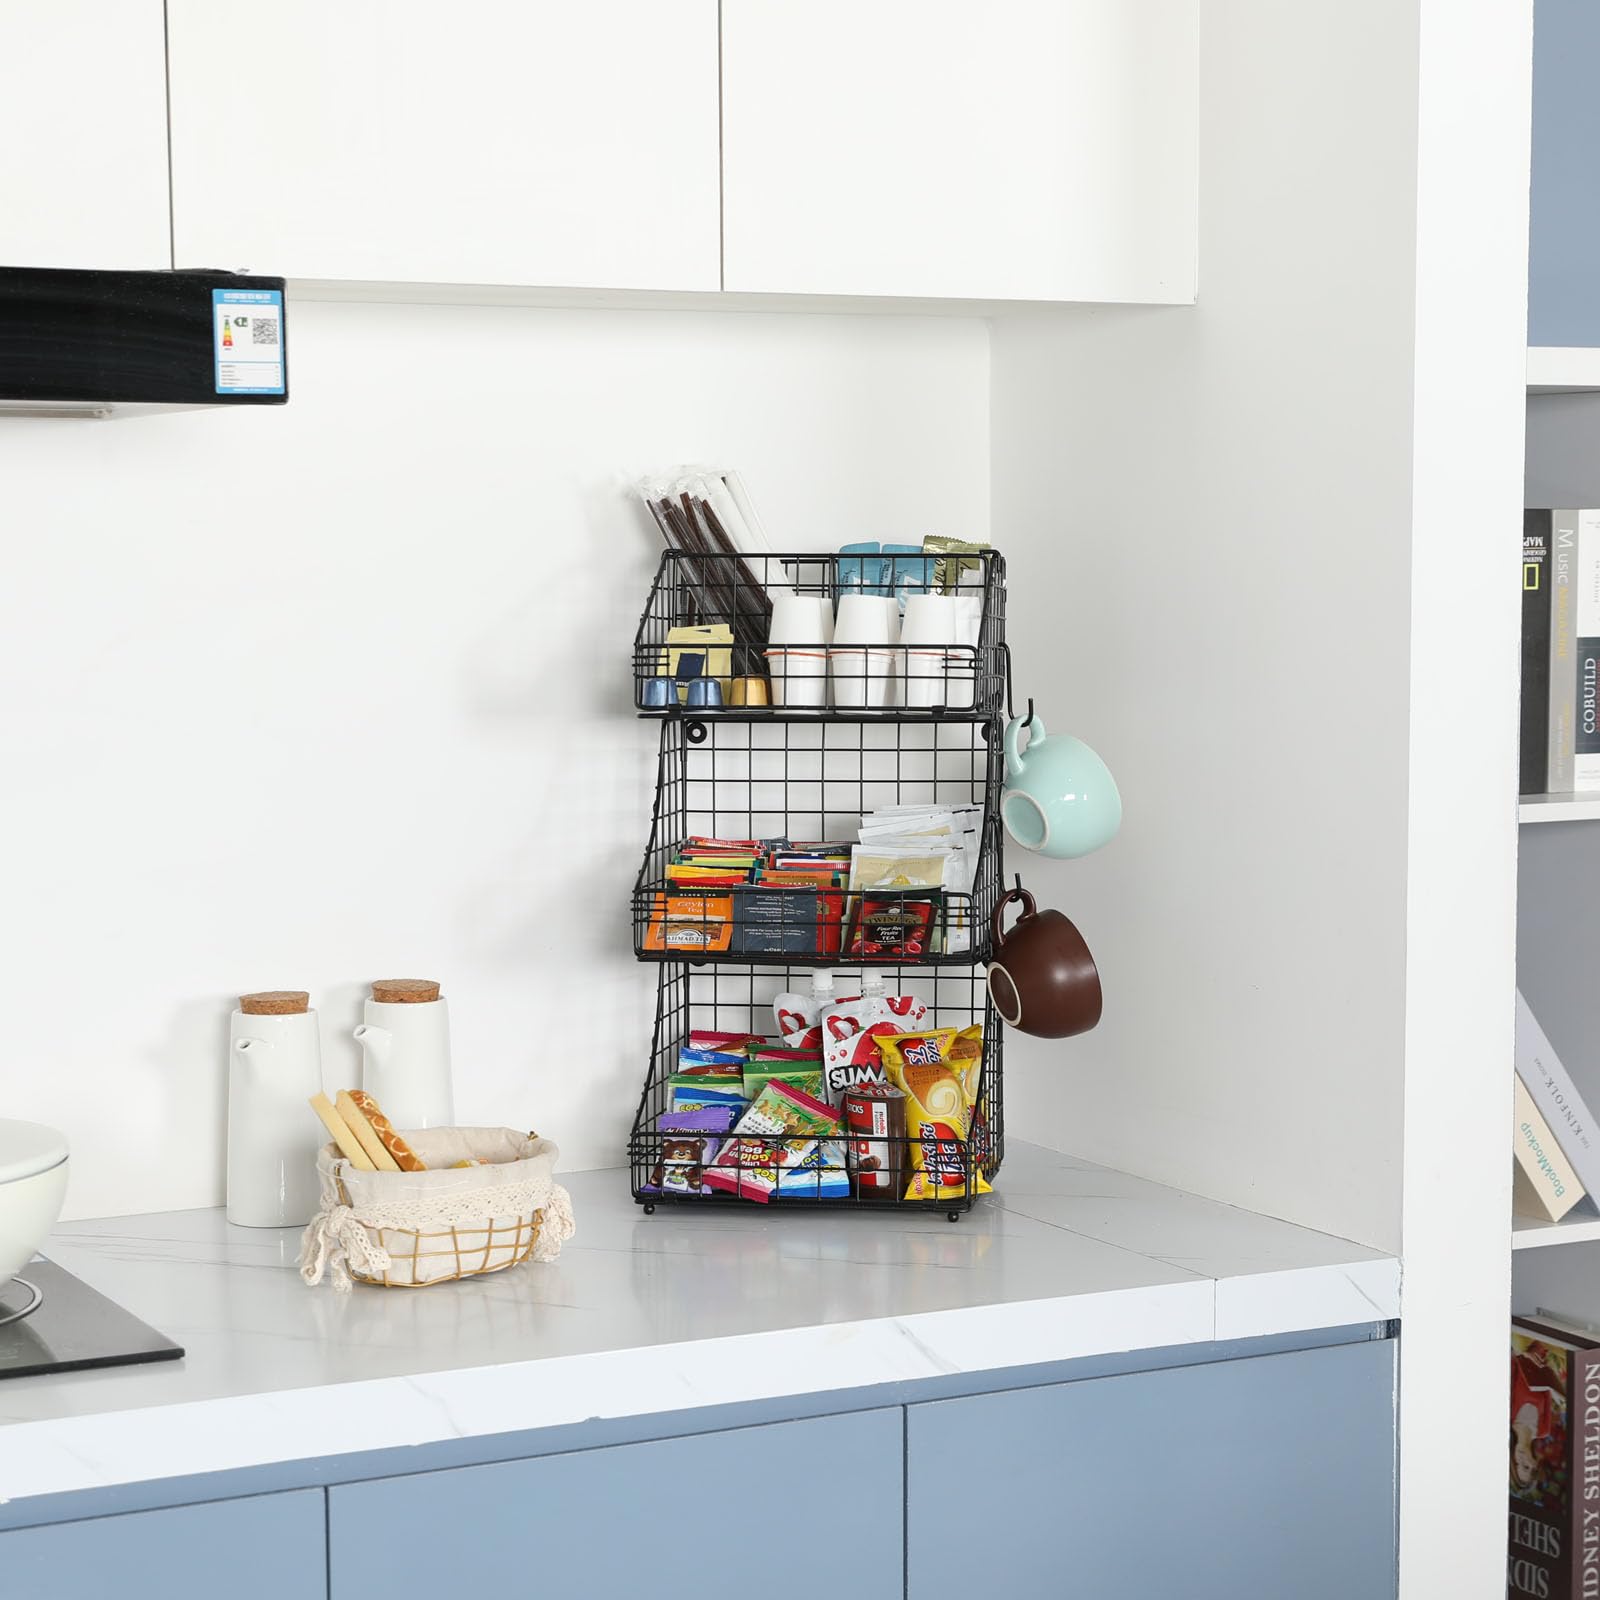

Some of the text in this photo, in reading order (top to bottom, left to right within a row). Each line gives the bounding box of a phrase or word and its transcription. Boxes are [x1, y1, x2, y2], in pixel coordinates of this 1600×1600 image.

[1583, 657, 1597, 734] COBUILD
[1545, 1077, 1584, 1137] KINFOLK
[1520, 1122, 1566, 1198] BookMockup
[1583, 1363, 1600, 1500] SHELDON
